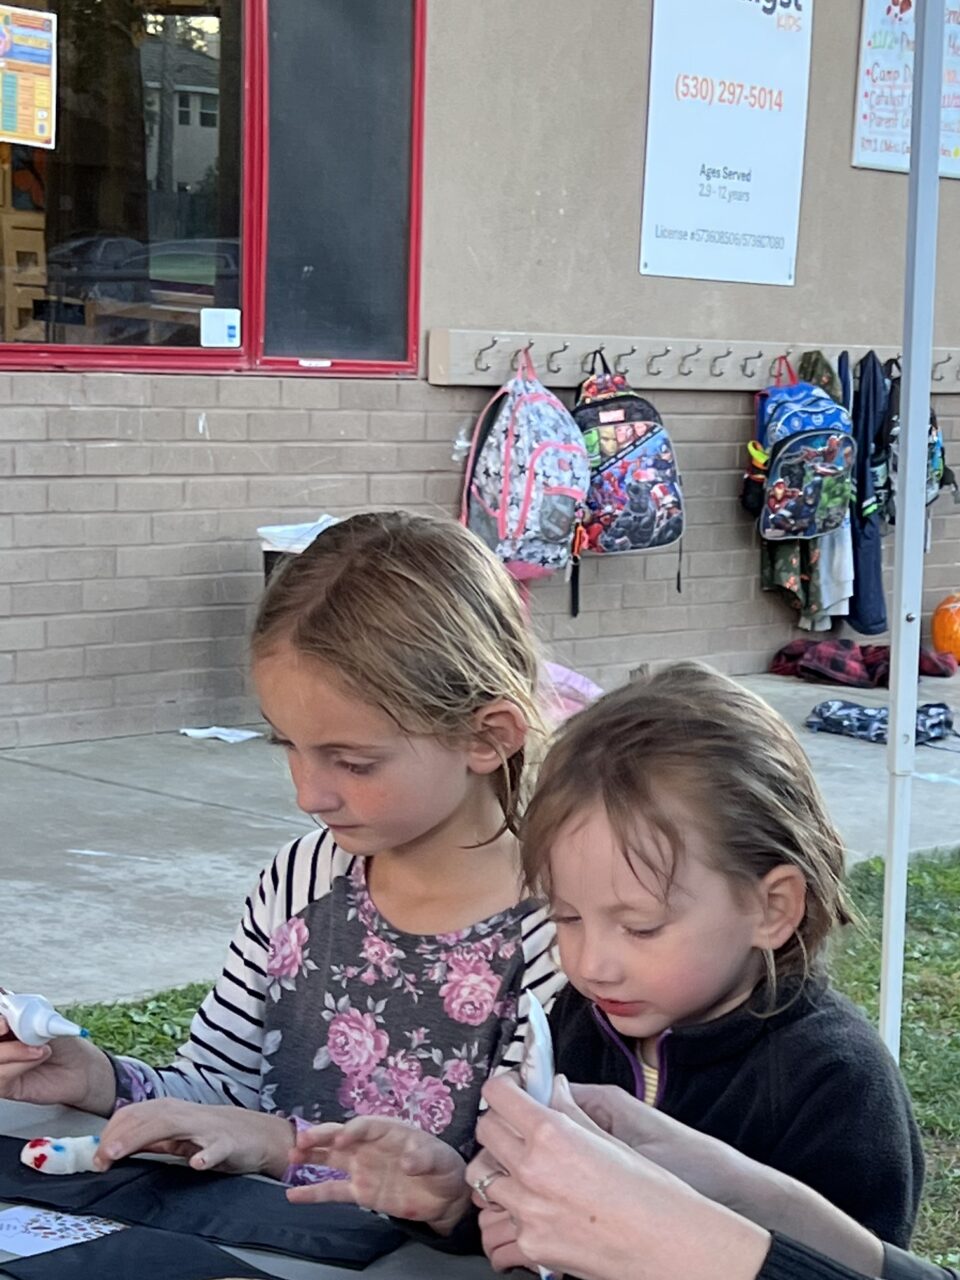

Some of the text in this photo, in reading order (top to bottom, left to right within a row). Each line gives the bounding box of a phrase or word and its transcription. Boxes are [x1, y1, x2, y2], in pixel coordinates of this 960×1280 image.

[675, 74, 783, 112] (530) 297-5014
[700, 164, 752, 183] Ages Served
